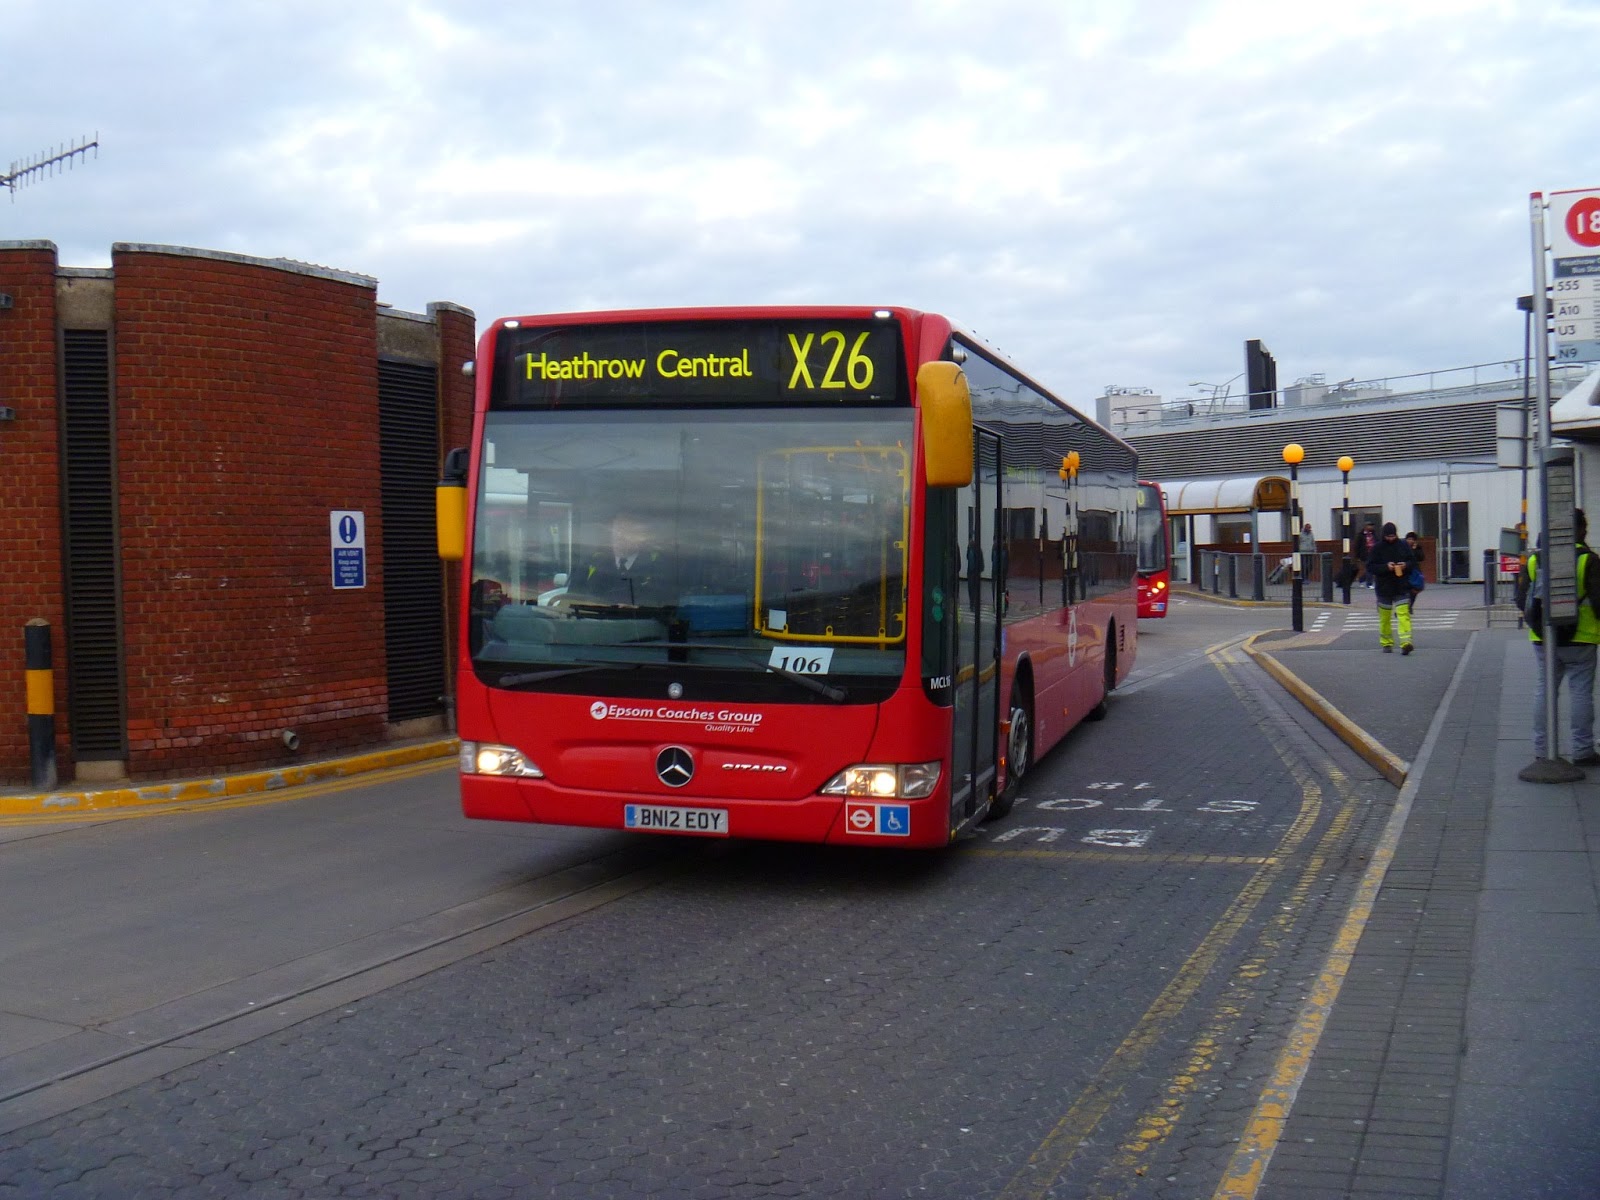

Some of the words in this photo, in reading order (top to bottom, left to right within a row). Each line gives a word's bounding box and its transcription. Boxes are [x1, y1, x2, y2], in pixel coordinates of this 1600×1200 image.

[1576, 209, 1600, 235] 18
[1556, 280, 1580, 292] 555
[1558, 305, 1580, 316] A10
[1557, 324, 1577, 336] U3
[787, 330, 875, 390] X26
[1558, 347, 1578, 359] N9
[526, 352, 646, 380] Heathrow
[656, 348, 753, 378] Central
[780, 656, 824, 673] 106
[607, 704, 654, 718] Epsom
[656, 707, 714, 720] Coaches
[717, 710, 763, 725] Group
[705, 724, 736, 733] Quality
[736, 725, 755, 733] Line
[641, 808, 680, 828] BN12
[685, 811, 721, 830] EOY
